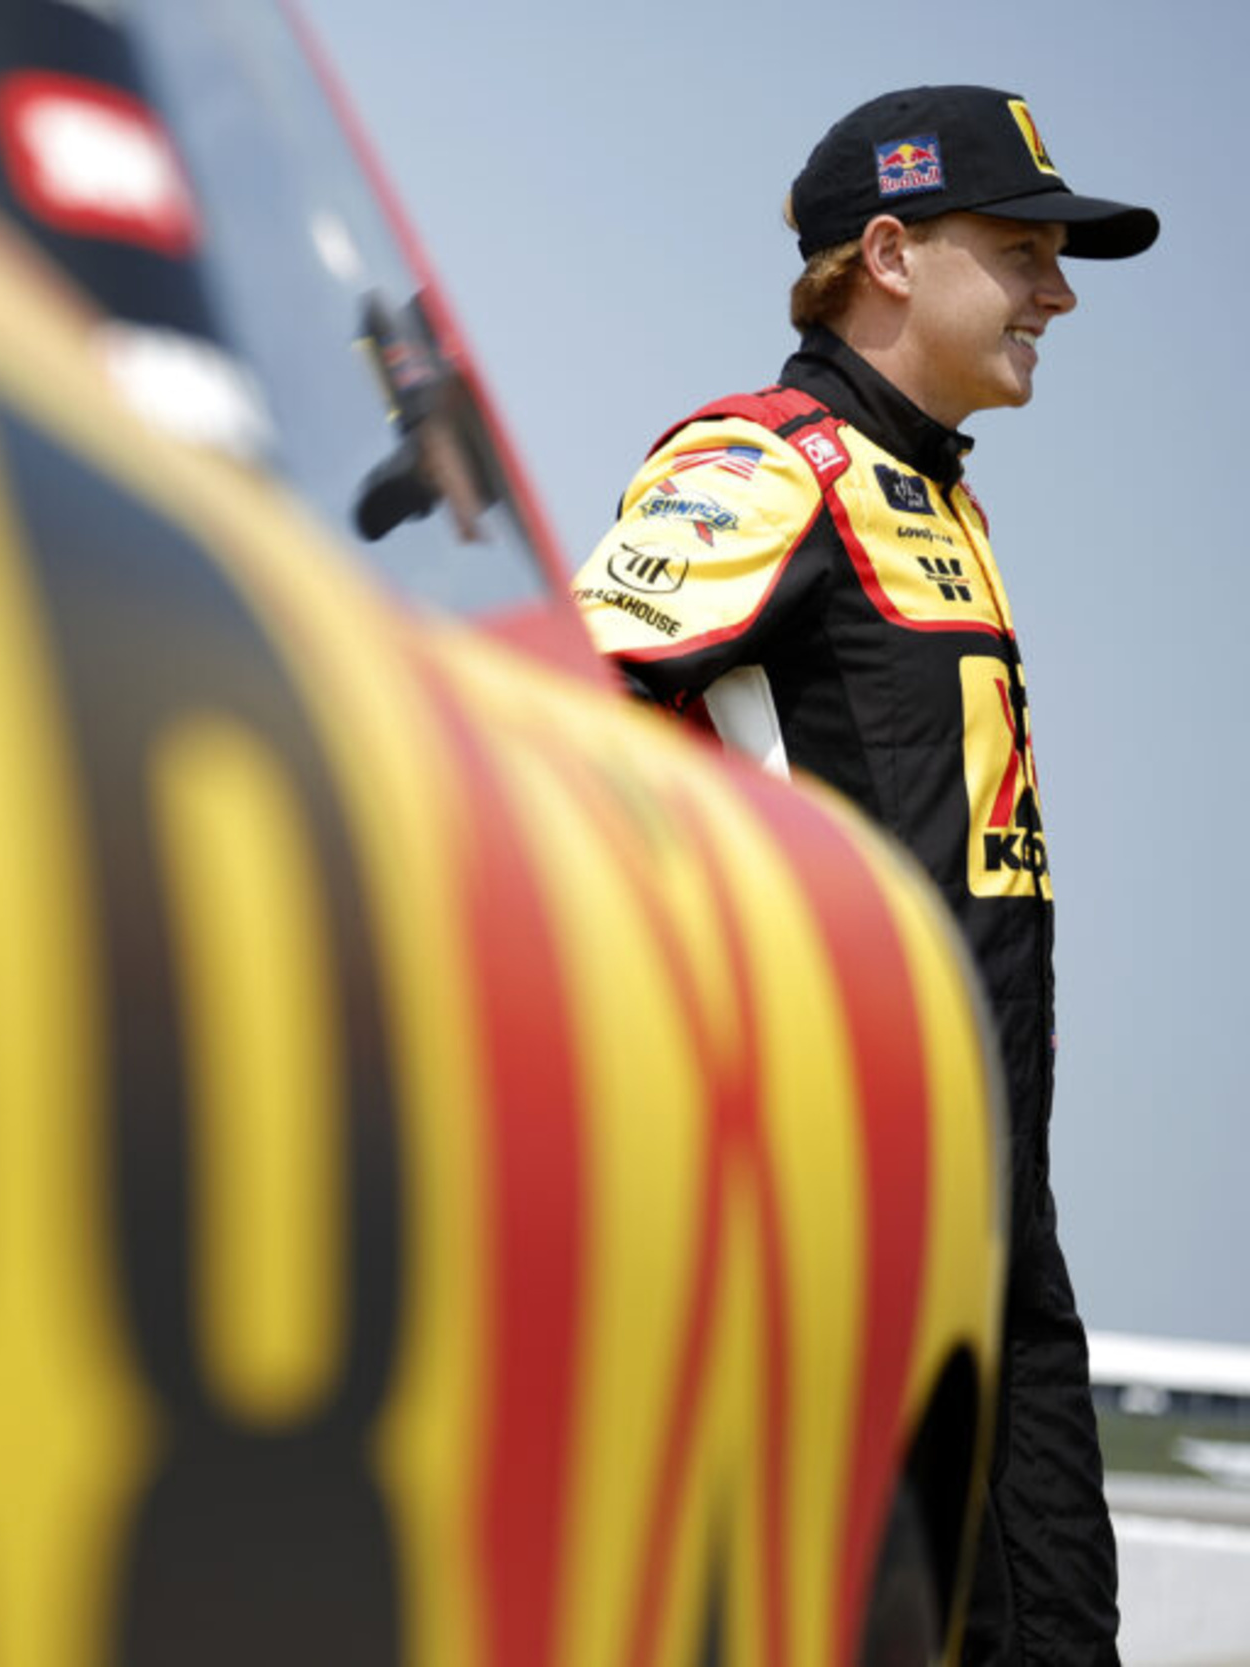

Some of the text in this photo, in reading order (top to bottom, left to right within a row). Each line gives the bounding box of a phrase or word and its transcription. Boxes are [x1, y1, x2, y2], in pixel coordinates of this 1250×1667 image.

[879, 165, 941, 193] Red Bull
[648, 498, 734, 528] SUNOCO
[569, 588, 682, 638] TRACKHOUSE
